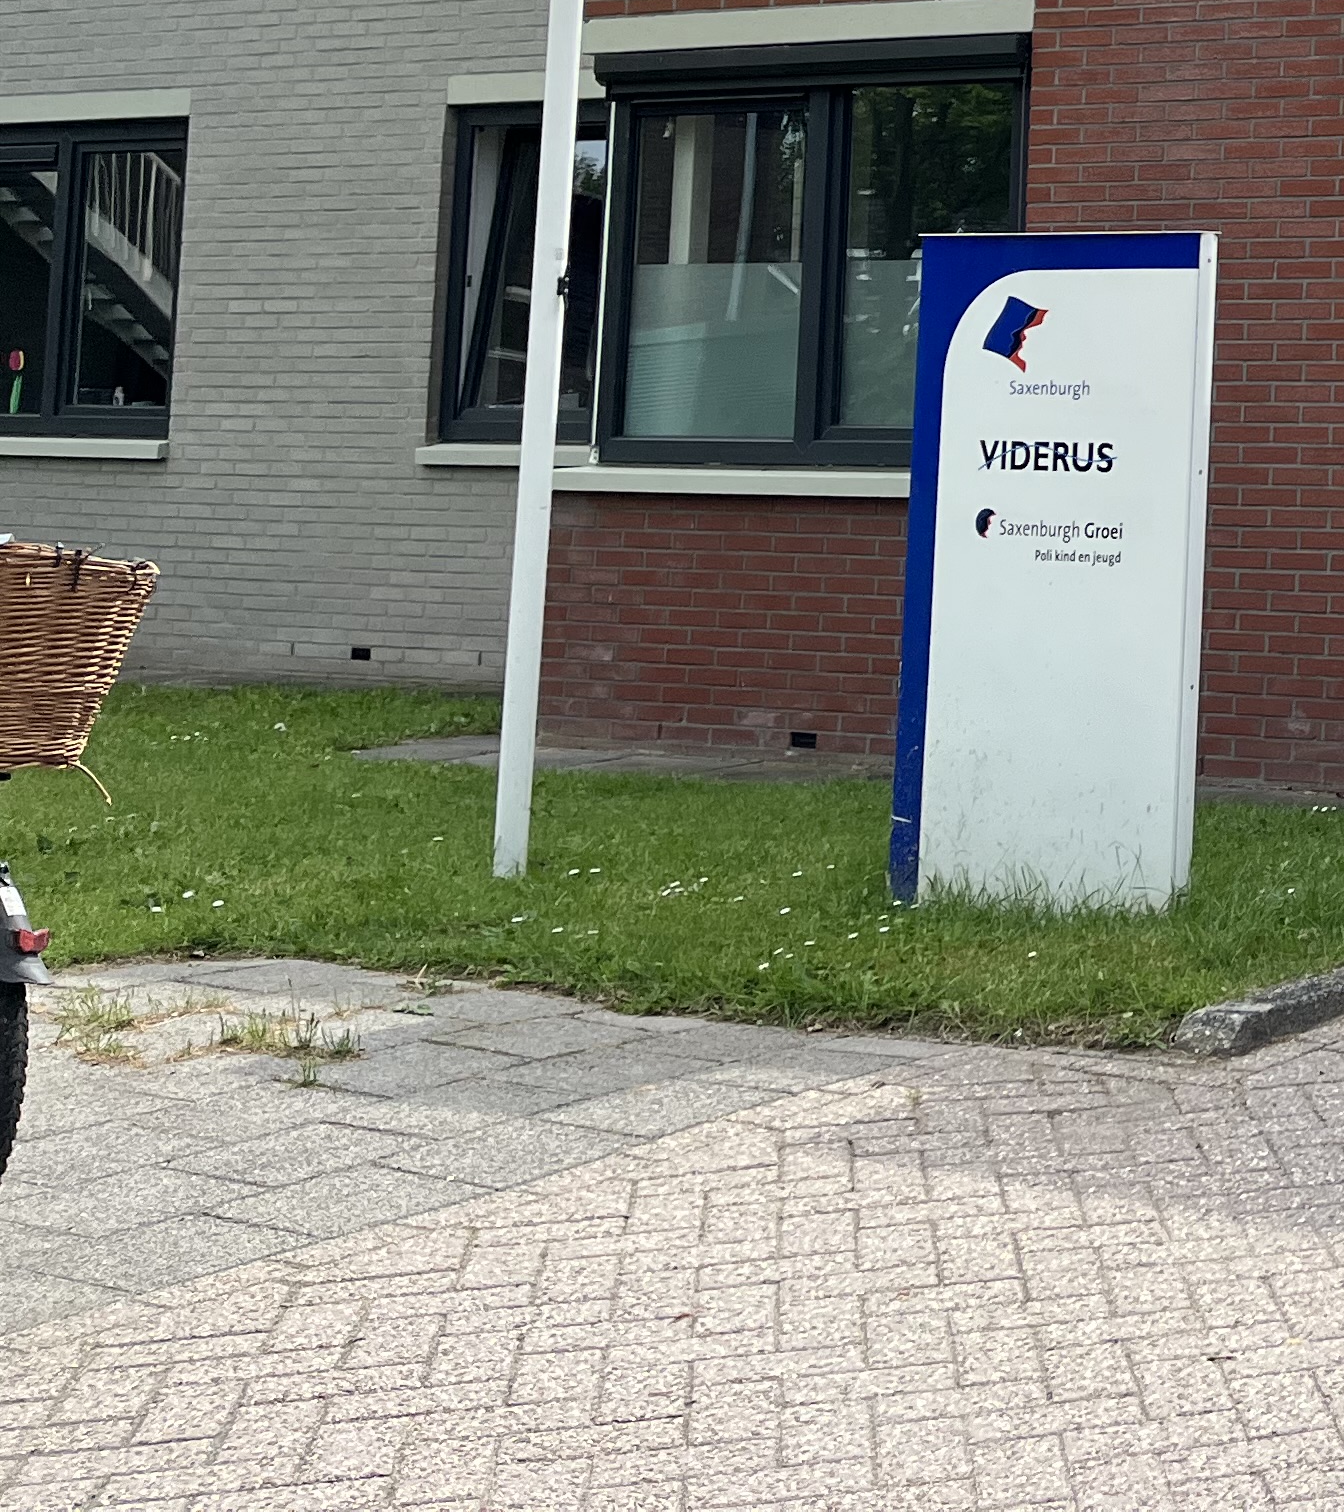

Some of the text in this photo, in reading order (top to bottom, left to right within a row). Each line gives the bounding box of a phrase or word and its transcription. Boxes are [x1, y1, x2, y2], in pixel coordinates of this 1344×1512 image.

[1009, 380, 1090, 400] Saxenburgh
[979, 439, 1115, 473] VIDERUS
[999, 519, 1123, 544] Saxenburgh Groei
[1034, 550, 1122, 567] Poli kind en jeugd
